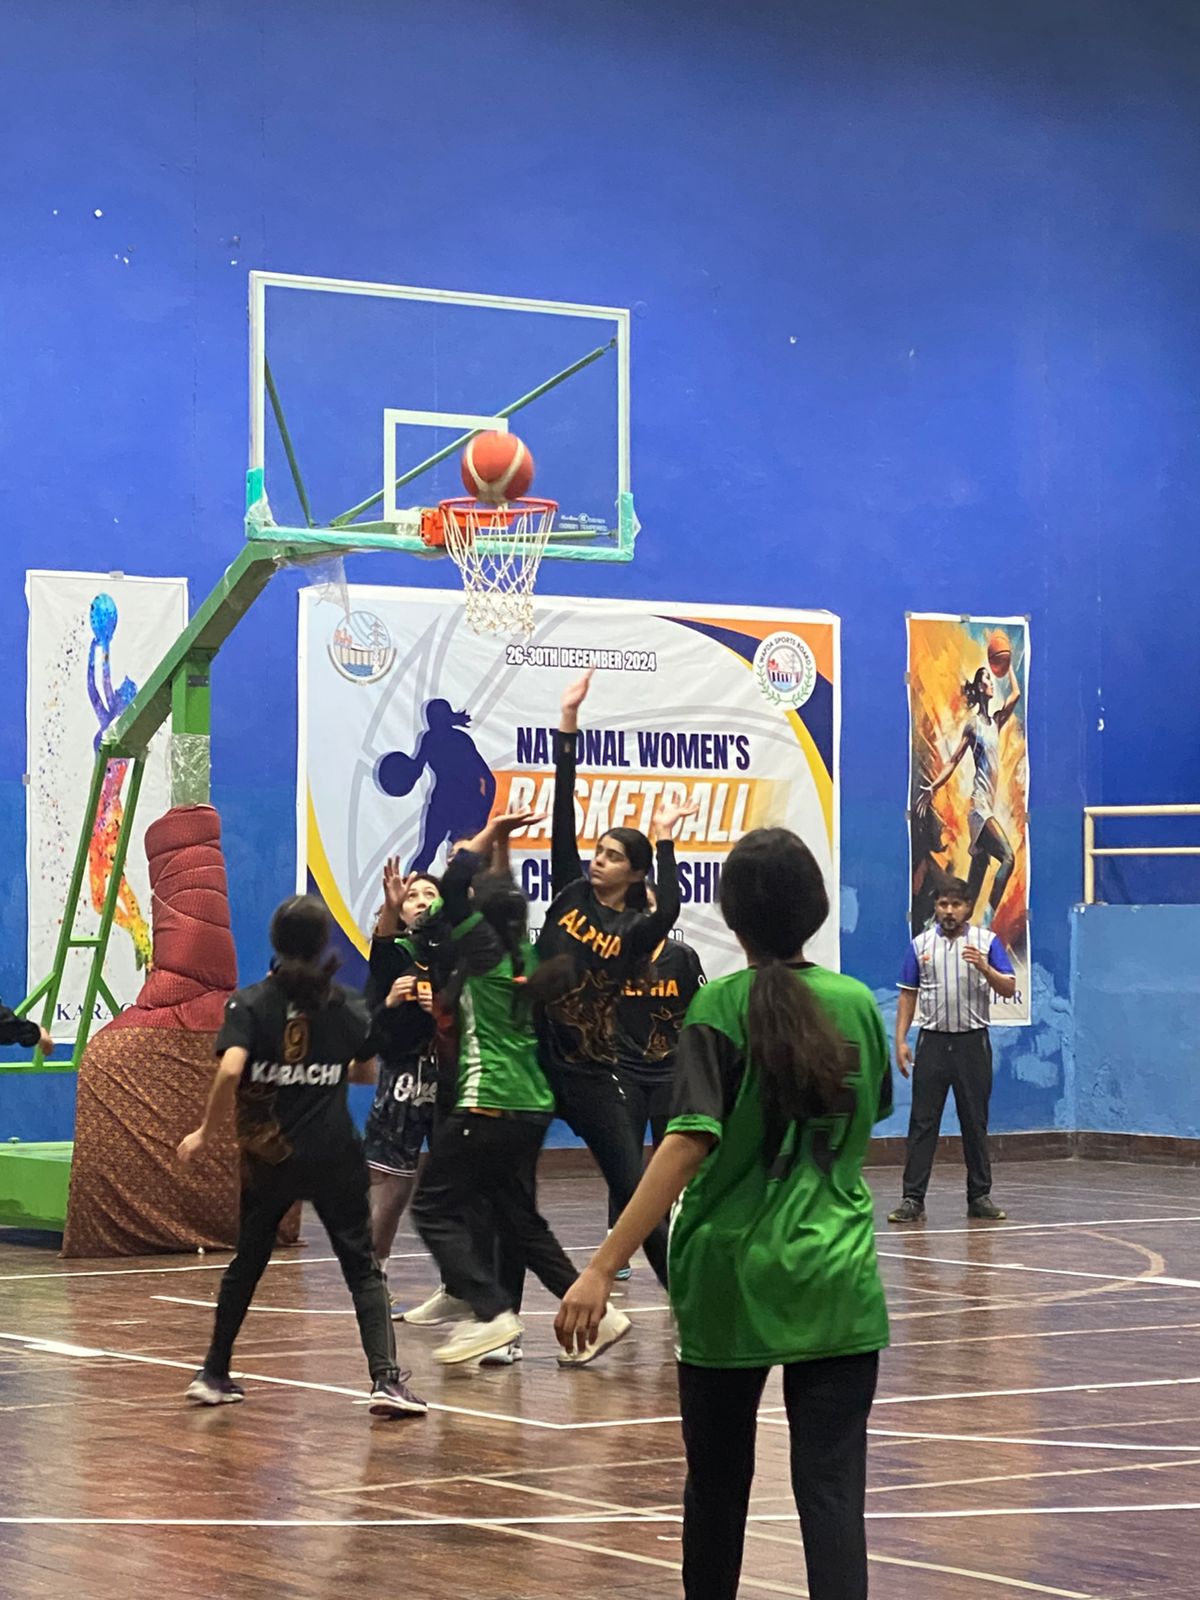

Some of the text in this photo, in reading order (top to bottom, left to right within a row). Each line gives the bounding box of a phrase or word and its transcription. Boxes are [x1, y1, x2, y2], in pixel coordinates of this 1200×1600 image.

[506, 645, 656, 672] 26-30TH DECEMBER 2024
[759, 636, 812, 666] WAPDA SPORTS BOARD
[637, 731, 750, 771] WOMEN'S
[557, 908, 622, 960] ALPHA
[284, 1018, 310, 1064] 9
[251, 1061, 342, 1086] KARACHI
